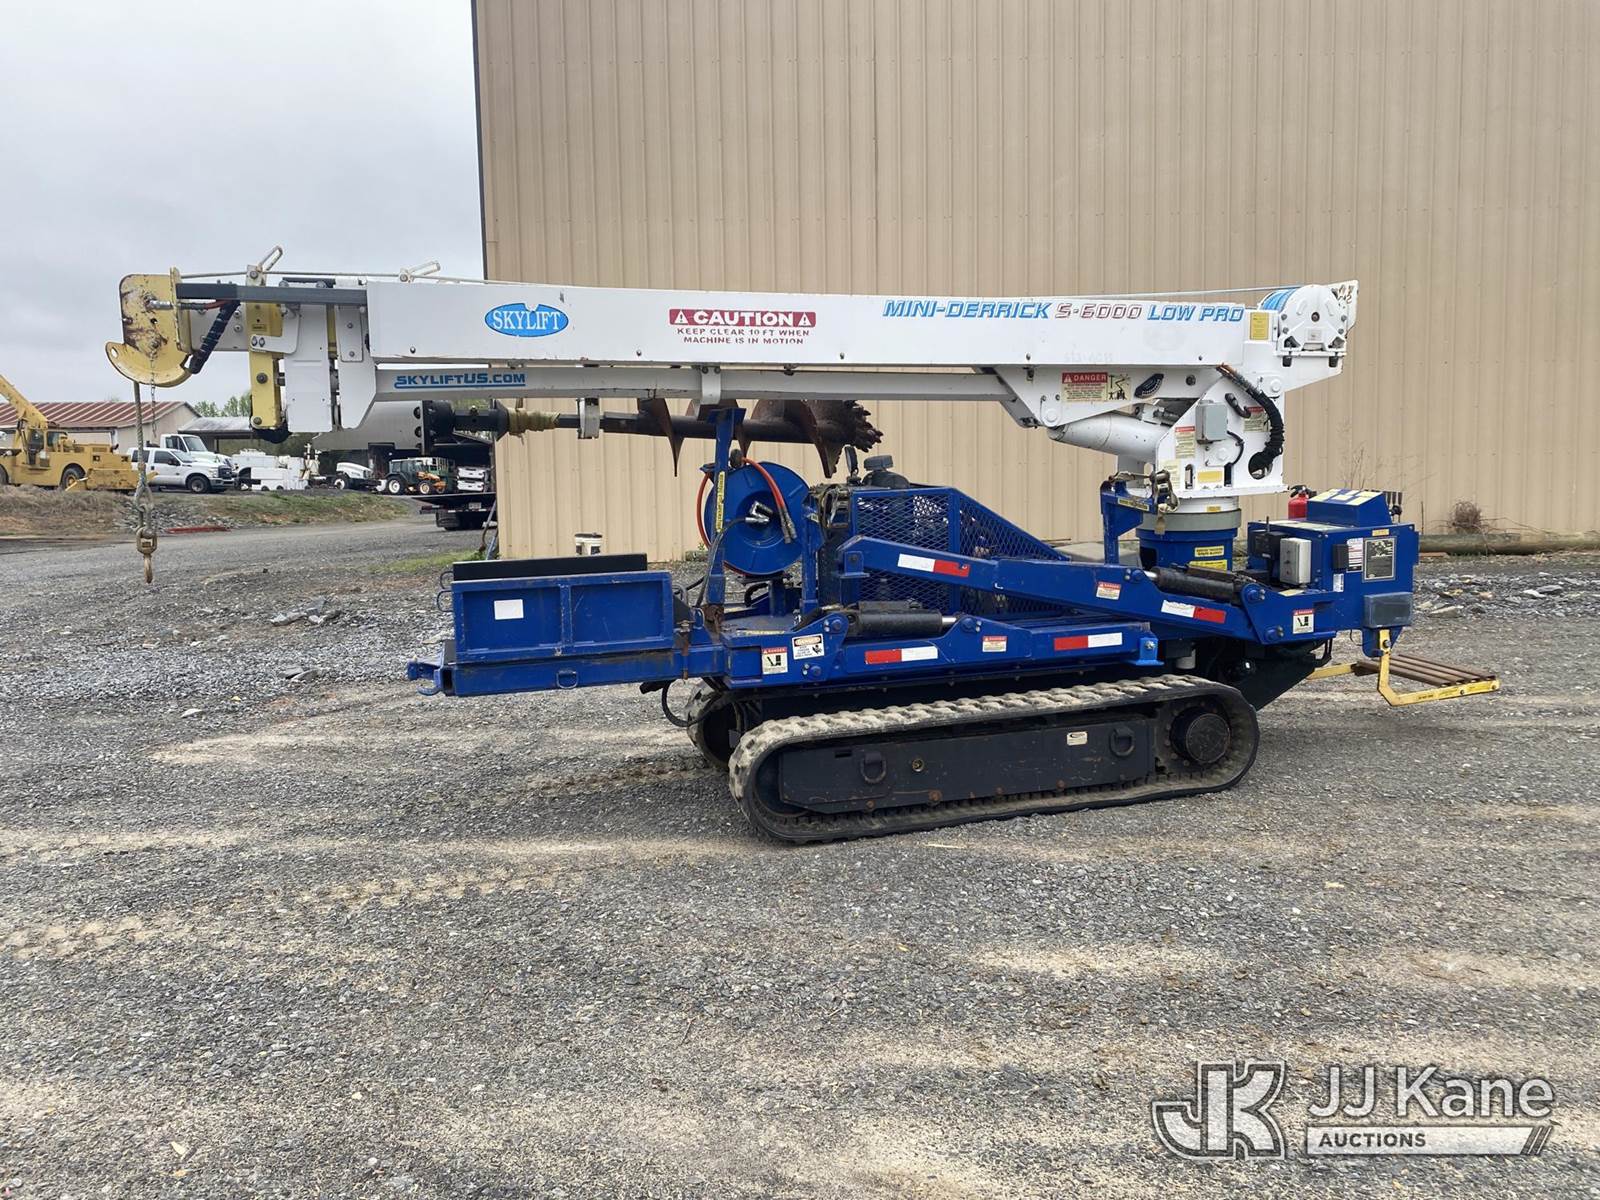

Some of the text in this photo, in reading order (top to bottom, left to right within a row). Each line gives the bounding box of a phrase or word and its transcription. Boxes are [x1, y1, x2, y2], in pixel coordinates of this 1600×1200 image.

[882, 300, 1245, 322] MINI-DERRICK S-6000 LOW PRO
[492, 310, 561, 331] SKYLIFT
[693, 310, 794, 327] CAUTION
[677, 328, 706, 336] KEEP
[710, 328, 744, 336] CLEAR
[763, 329, 775, 337] FT
[778, 329, 810, 337] WHEN
[683, 336, 732, 344] MACHINE
[763, 337, 804, 345] MOTION
[395, 372, 526, 385] SKYLIFTUS.COM
[1073, 373, 1107, 382] DANGER
